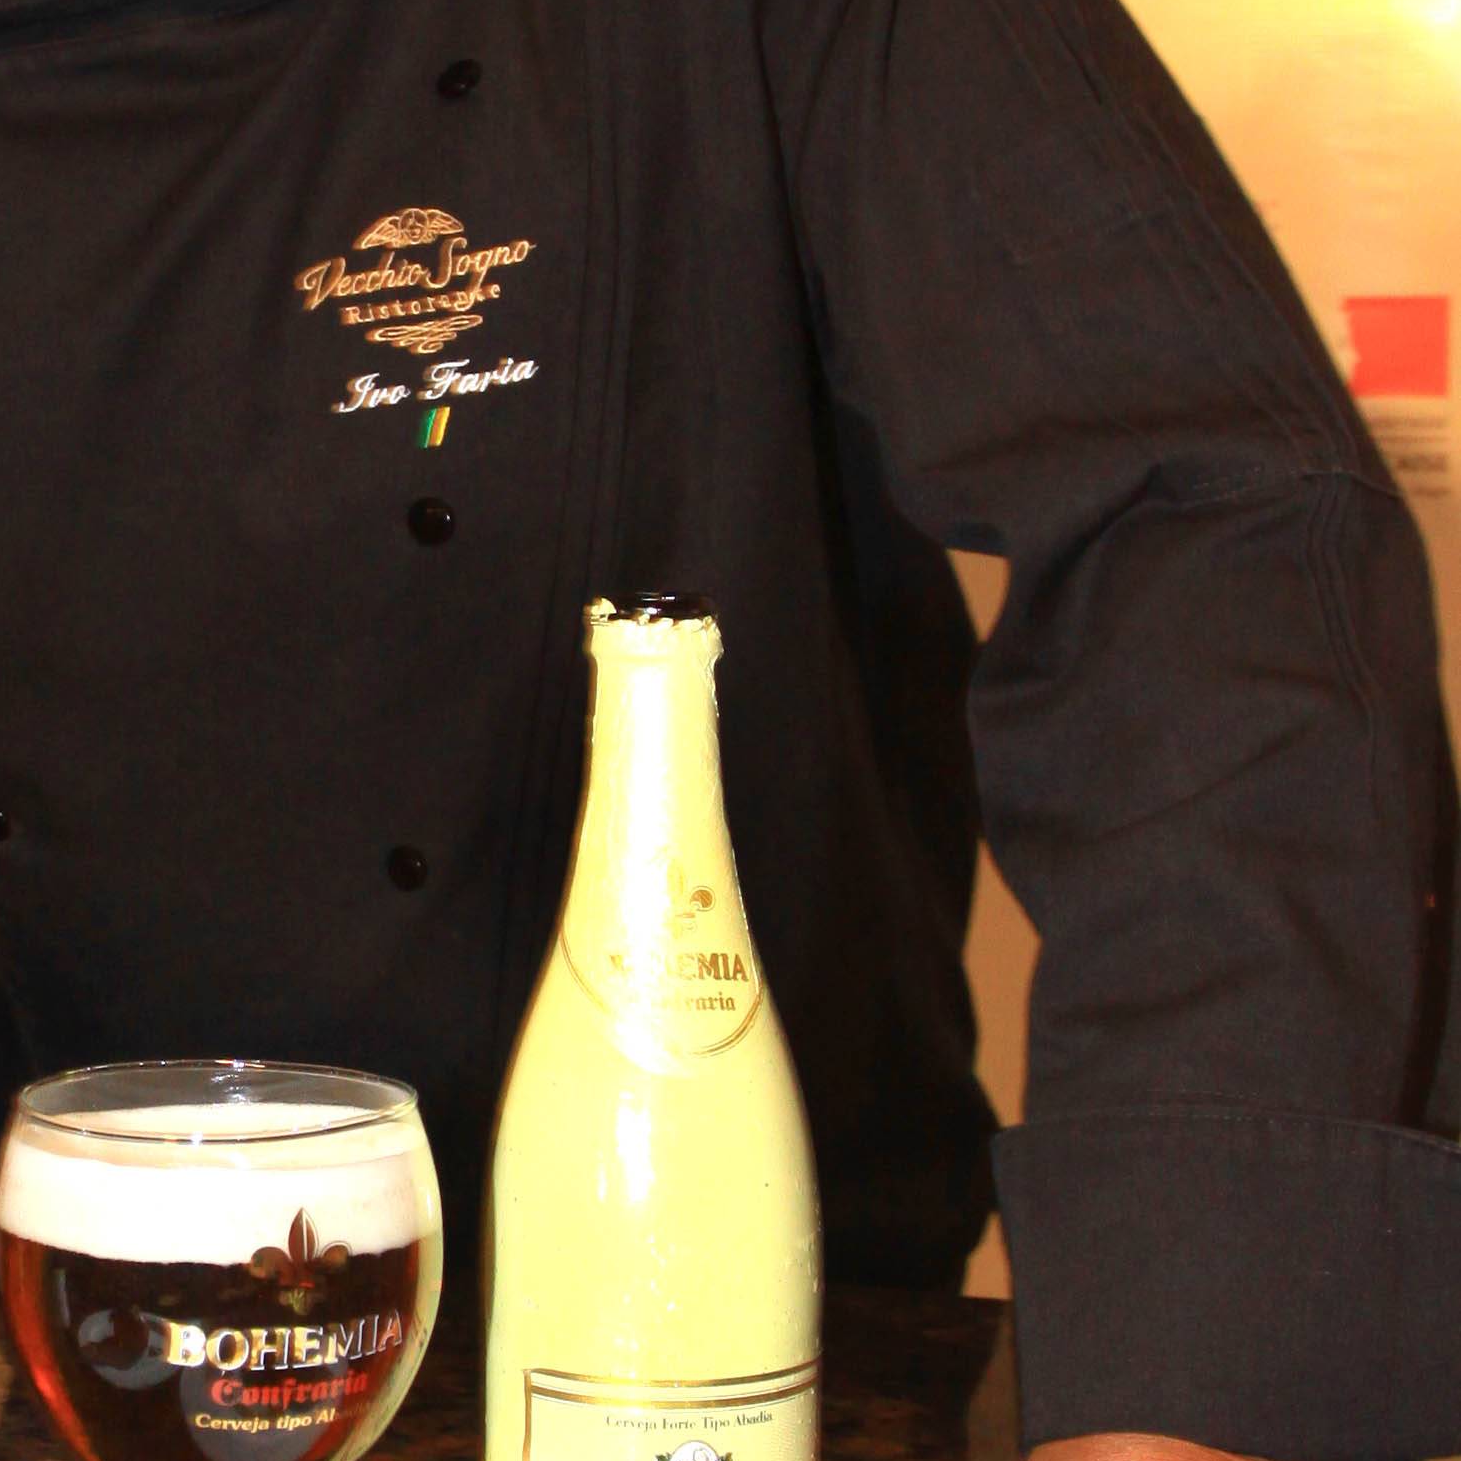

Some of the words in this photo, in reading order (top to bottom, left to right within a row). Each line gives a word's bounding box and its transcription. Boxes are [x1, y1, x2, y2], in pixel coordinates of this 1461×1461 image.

[297, 251, 426, 311] Vecchio
[342, 283, 501, 323] Ristorante
[335, 371, 411, 414] Ivo
[418, 357, 538, 401] Faria
[166, 1309, 405, 1371] BOHEMIA
[210, 1368, 369, 1411] Confraria
[194, 1412, 271, 1435] Cerveja
[276, 1414, 313, 1432] tipo
[662, 1417, 697, 1431] Forte
[702, 1416, 731, 1431] Tipo
[734, 1410, 774, 1427] Abadia
